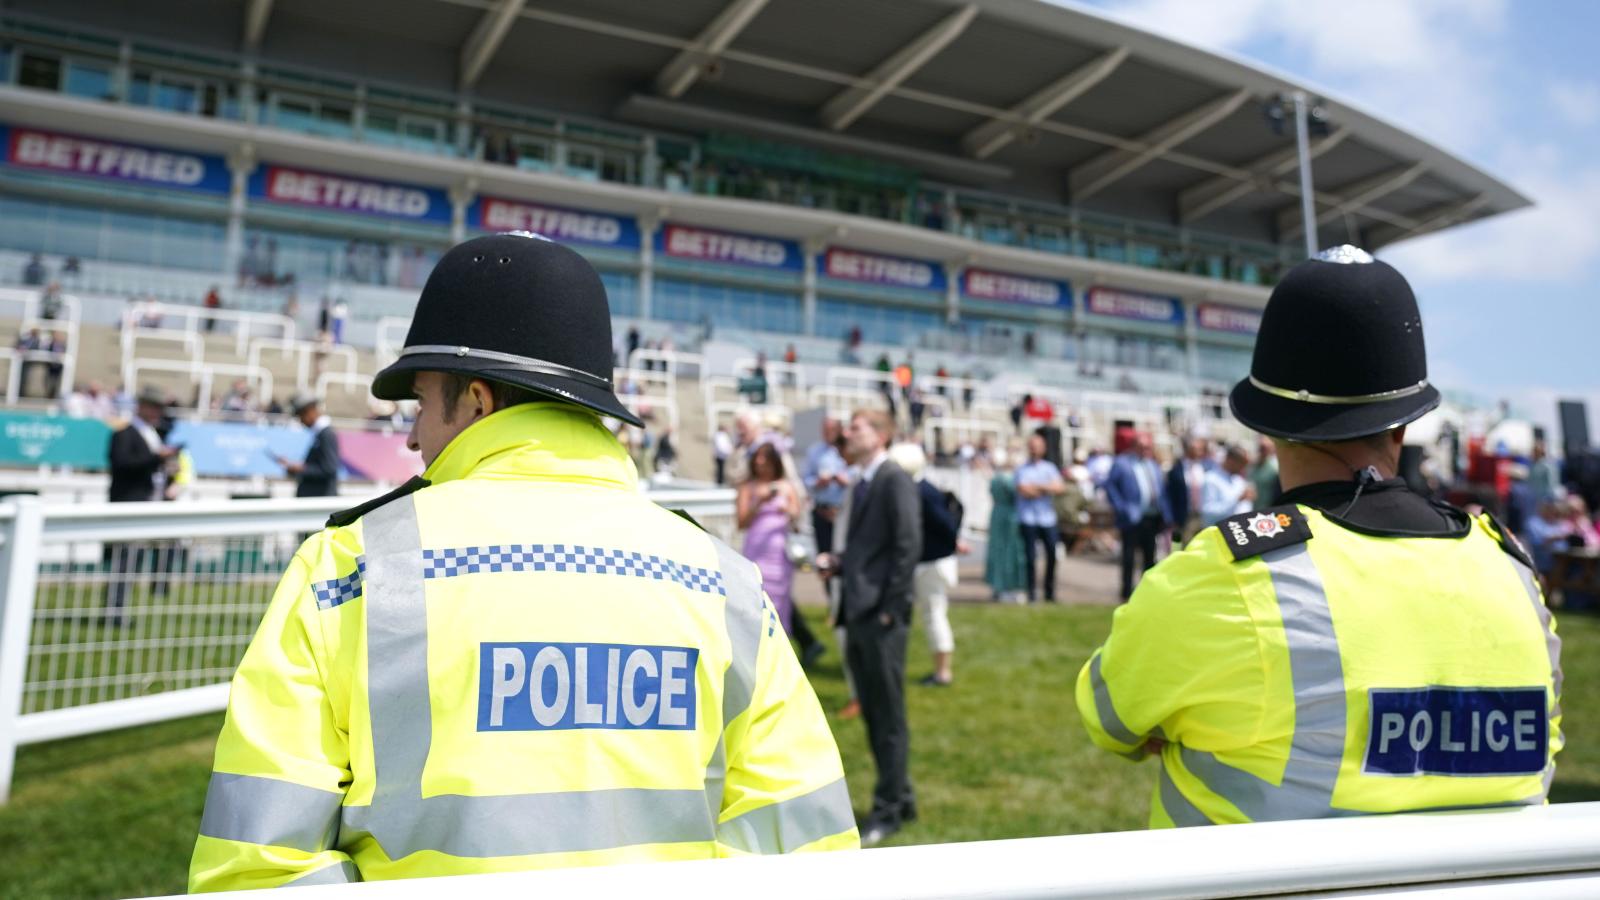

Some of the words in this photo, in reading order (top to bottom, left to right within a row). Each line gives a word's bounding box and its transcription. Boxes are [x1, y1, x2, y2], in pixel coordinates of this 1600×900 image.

[14, 131, 205, 186] BETFRED
[271, 169, 430, 218] BETFRED
[486, 201, 622, 242] BETFRED
[669, 226, 787, 266] BETFRED
[828, 249, 933, 287] BETFRED
[489, 645, 688, 727] POLICE
[1378, 709, 1537, 754] POLICE
